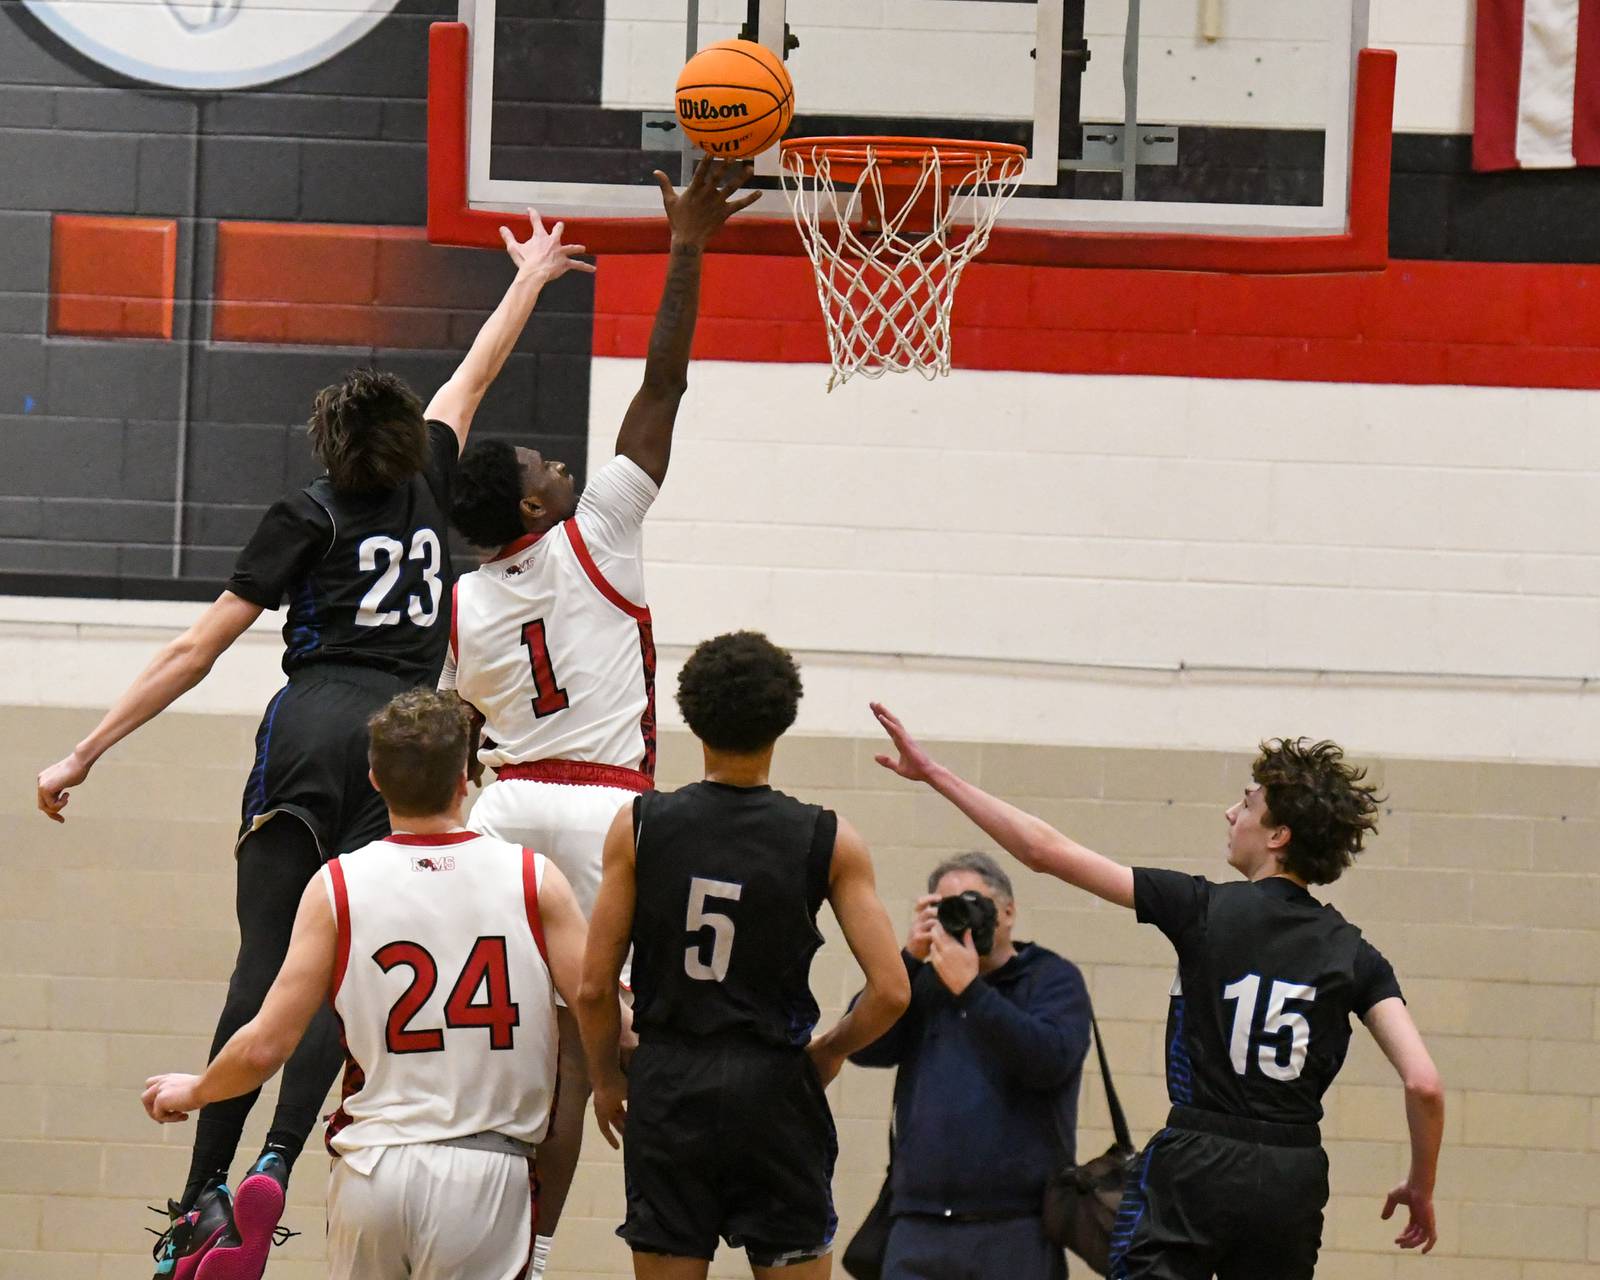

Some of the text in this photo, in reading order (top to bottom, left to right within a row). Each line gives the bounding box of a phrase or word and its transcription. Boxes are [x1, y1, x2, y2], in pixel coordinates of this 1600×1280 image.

[678, 98, 749, 119] Wilson
[355, 528, 443, 627] 23
[520, 617, 569, 719] 1
[684, 877, 742, 983] 5
[371, 936, 520, 1055] 24
[1223, 974, 1317, 1081] 15
